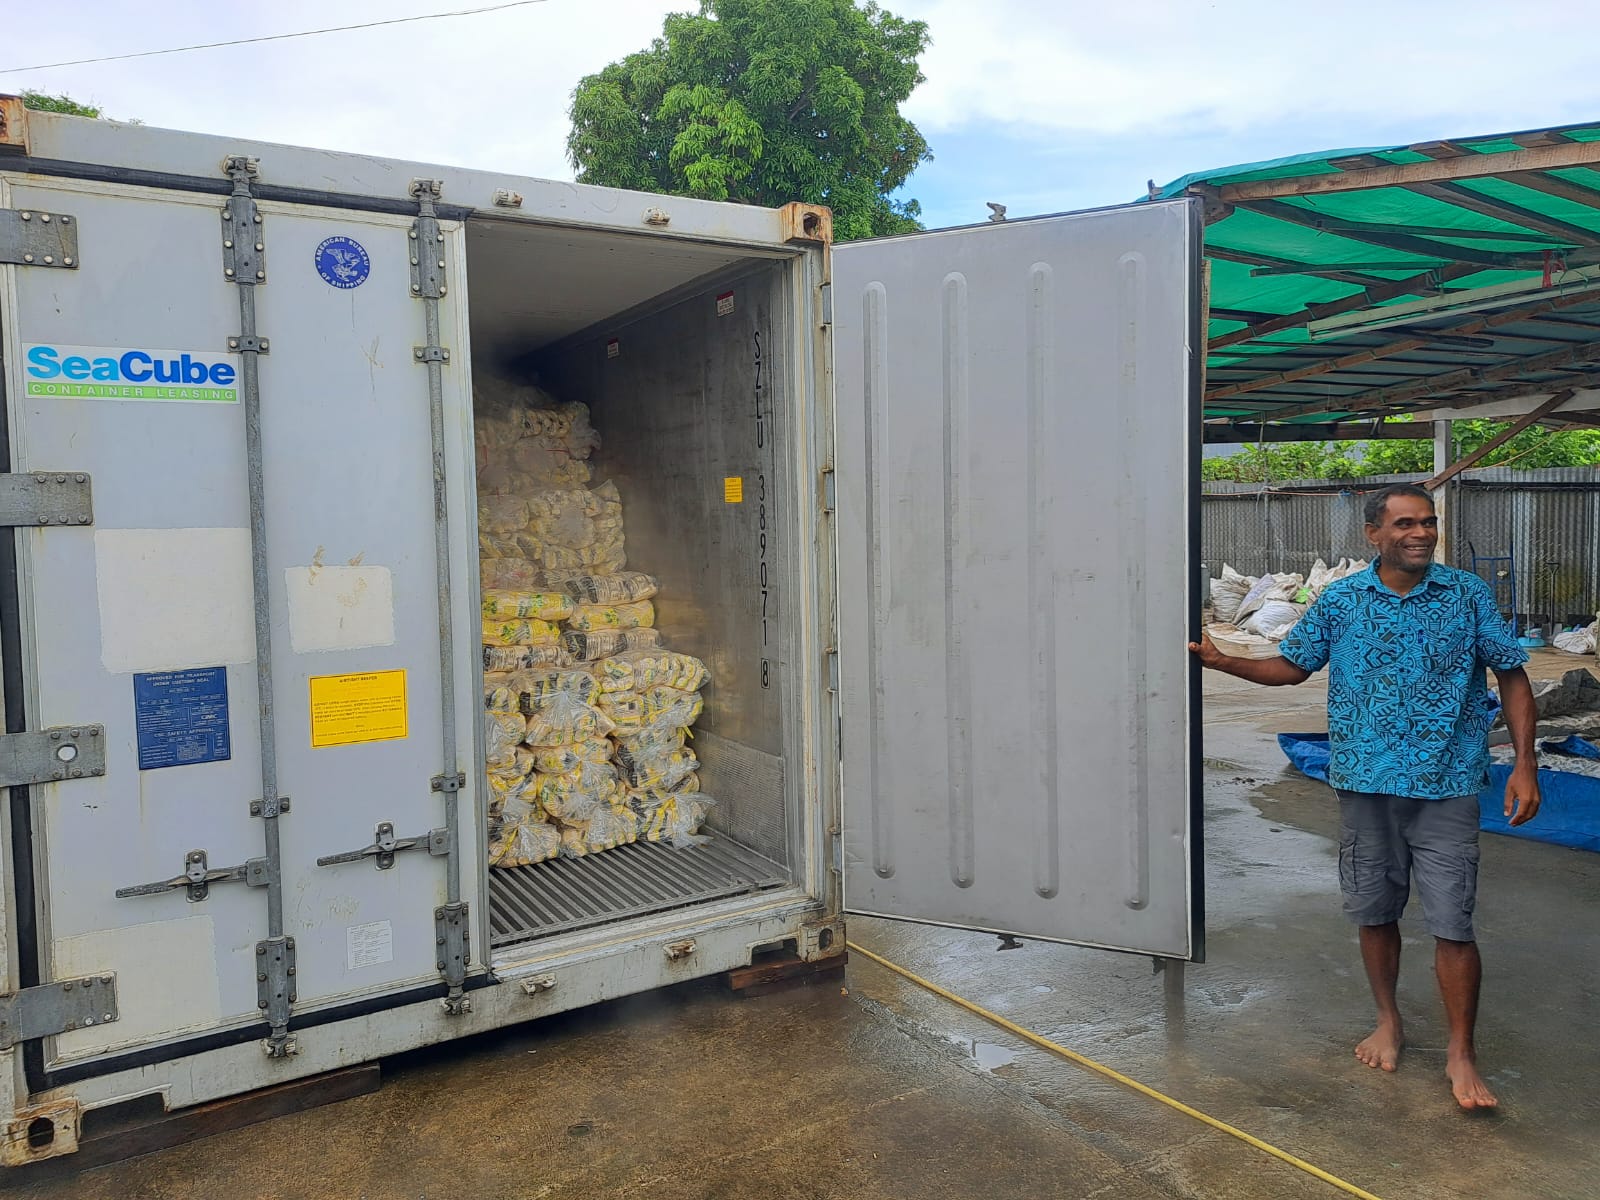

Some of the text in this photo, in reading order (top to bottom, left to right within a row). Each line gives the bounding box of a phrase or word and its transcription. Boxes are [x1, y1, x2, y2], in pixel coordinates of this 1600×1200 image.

[316, 237, 369, 266] AMERICAN BUREAU
[321, 272, 366, 288] OF SHIPPING
[27, 346, 236, 386] SeaCube
[32, 384, 234, 400] CONTAINER LEASING
[754, 331, 769, 687] SZLU 389071 8
